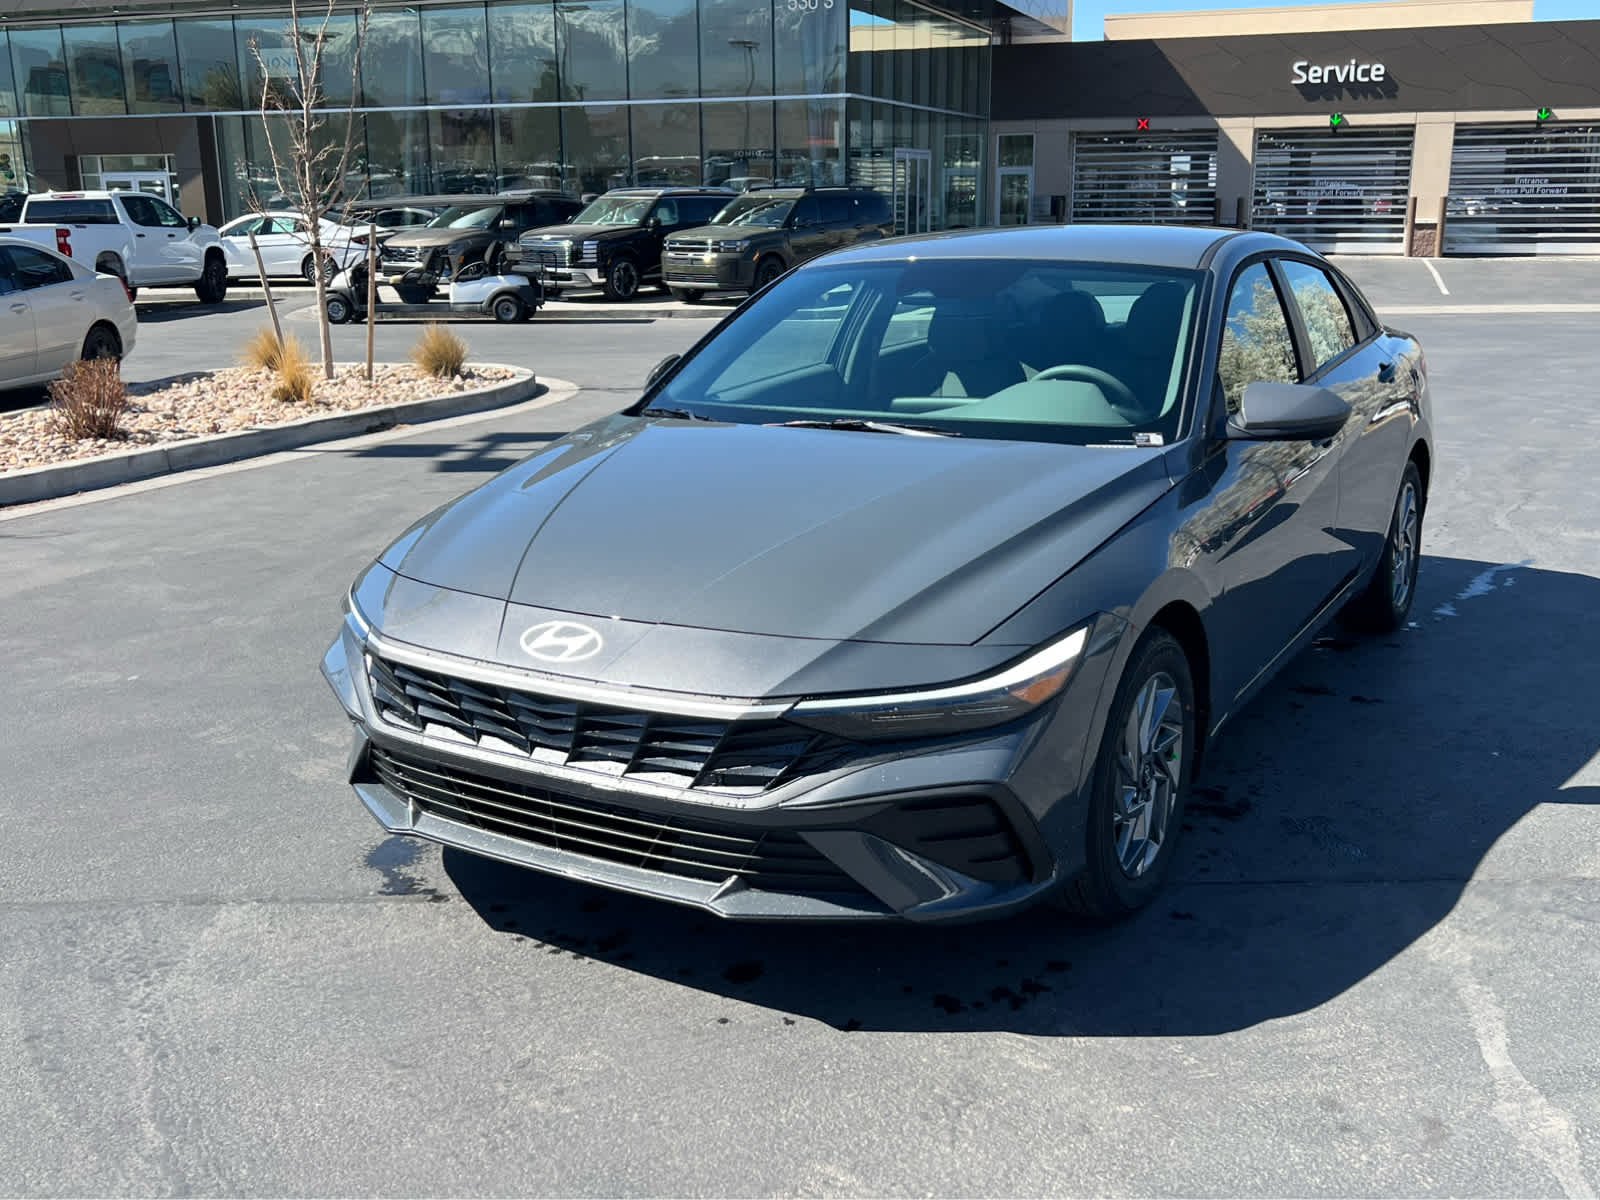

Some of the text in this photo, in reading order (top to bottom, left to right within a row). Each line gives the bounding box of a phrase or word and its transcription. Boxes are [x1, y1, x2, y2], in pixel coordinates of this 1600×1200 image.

[1290, 58, 1386, 84] Service
[1514, 176, 1549, 184] Entrance
[1494, 185, 1568, 194] Please Pull Forward
